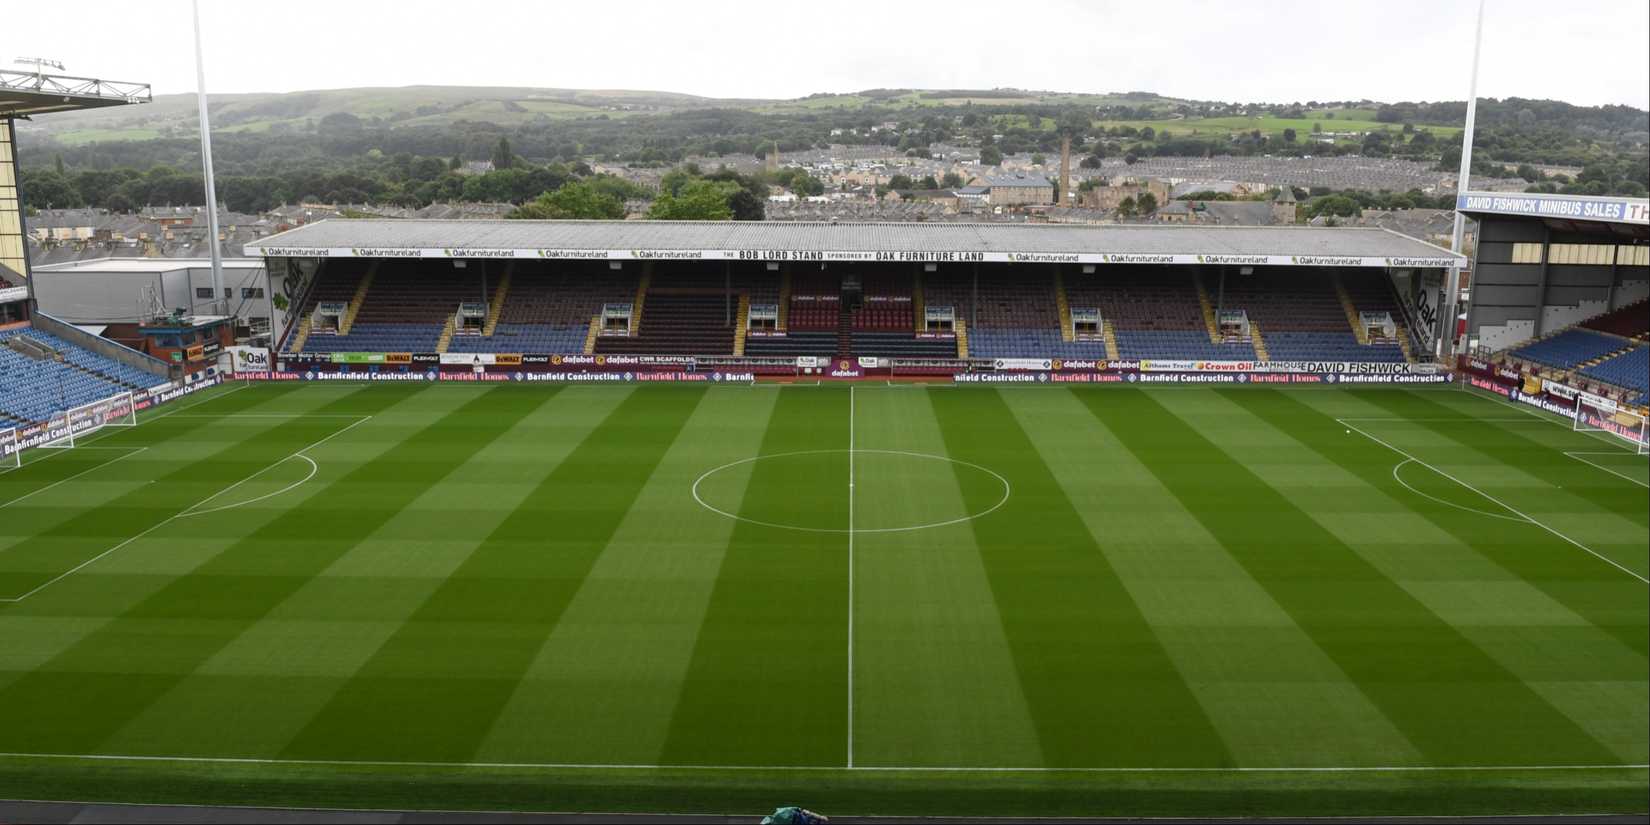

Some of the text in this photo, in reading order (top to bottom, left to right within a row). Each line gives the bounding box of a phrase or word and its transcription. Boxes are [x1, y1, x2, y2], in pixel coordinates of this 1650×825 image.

[1466, 196, 1621, 220] DAVID FISHWICK MINIBUS SALES
[739, 250, 759, 260] BOB
[763, 250, 788, 261] LORD
[792, 251, 823, 261] STAND
[876, 252, 895, 262] OAK
[899, 252, 955, 262] FURNITURE
[958, 252, 984, 262] LAND
[247, 351, 267, 364] Oak
[562, 355, 594, 364] dafabet
[606, 356, 638, 365] dafabet
[1063, 359, 1095, 370] dafabet
[1108, 360, 1140, 370] dafabet
[1205, 362, 1253, 371] Crown Oil
[1307, 362, 1345, 374] DAVID
[1349, 362, 1411, 374] FISHWICK
[371, 371, 424, 381] Construction
[527, 372, 621, 381] Barnfield Construction
[832, 369, 859, 378] dafabet
[981, 373, 1035, 382] Construction
[1140, 373, 1234, 383] Barnfield Construction
[1393, 374, 1445, 383] Construction
